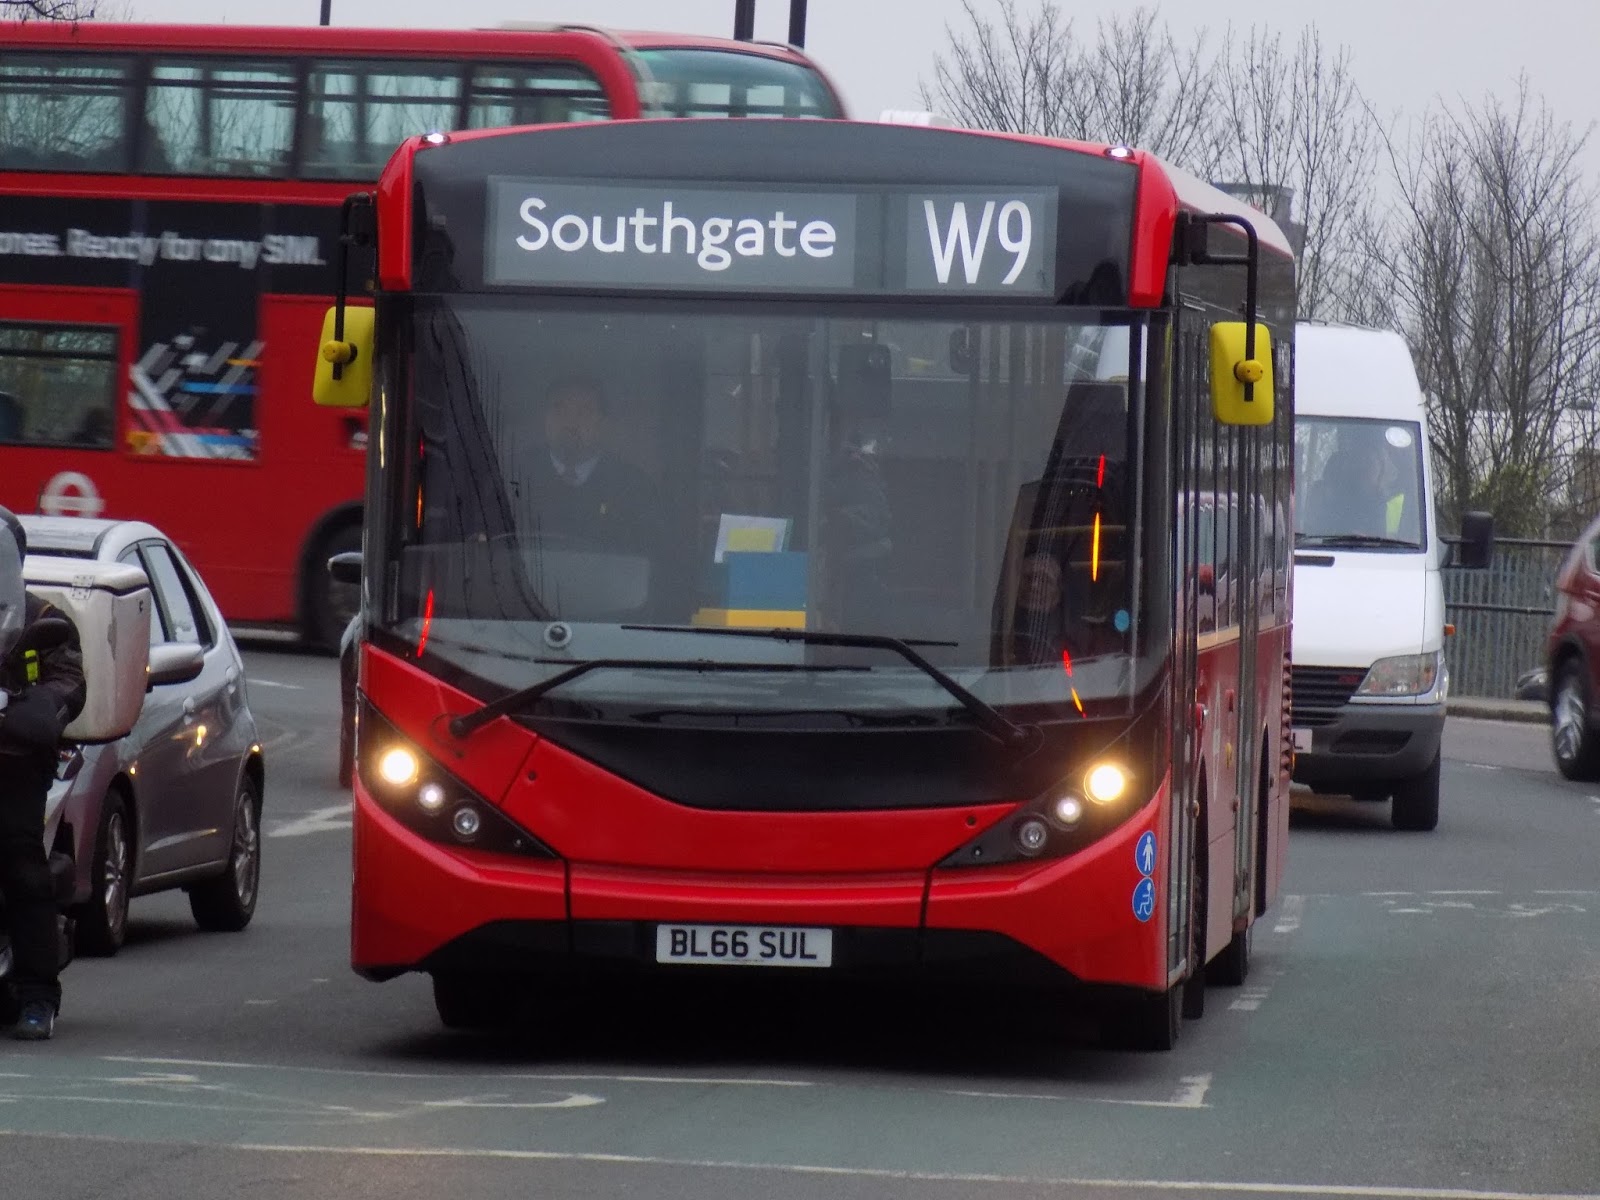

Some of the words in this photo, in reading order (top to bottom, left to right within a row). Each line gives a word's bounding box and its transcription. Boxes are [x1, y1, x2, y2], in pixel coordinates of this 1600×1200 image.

[67, 228, 160, 266] Ready
[516, 197, 837, 271] Southgate
[923, 199, 1032, 285] W9
[670, 928, 749, 958] BL66
[759, 930, 818, 960] SUL
